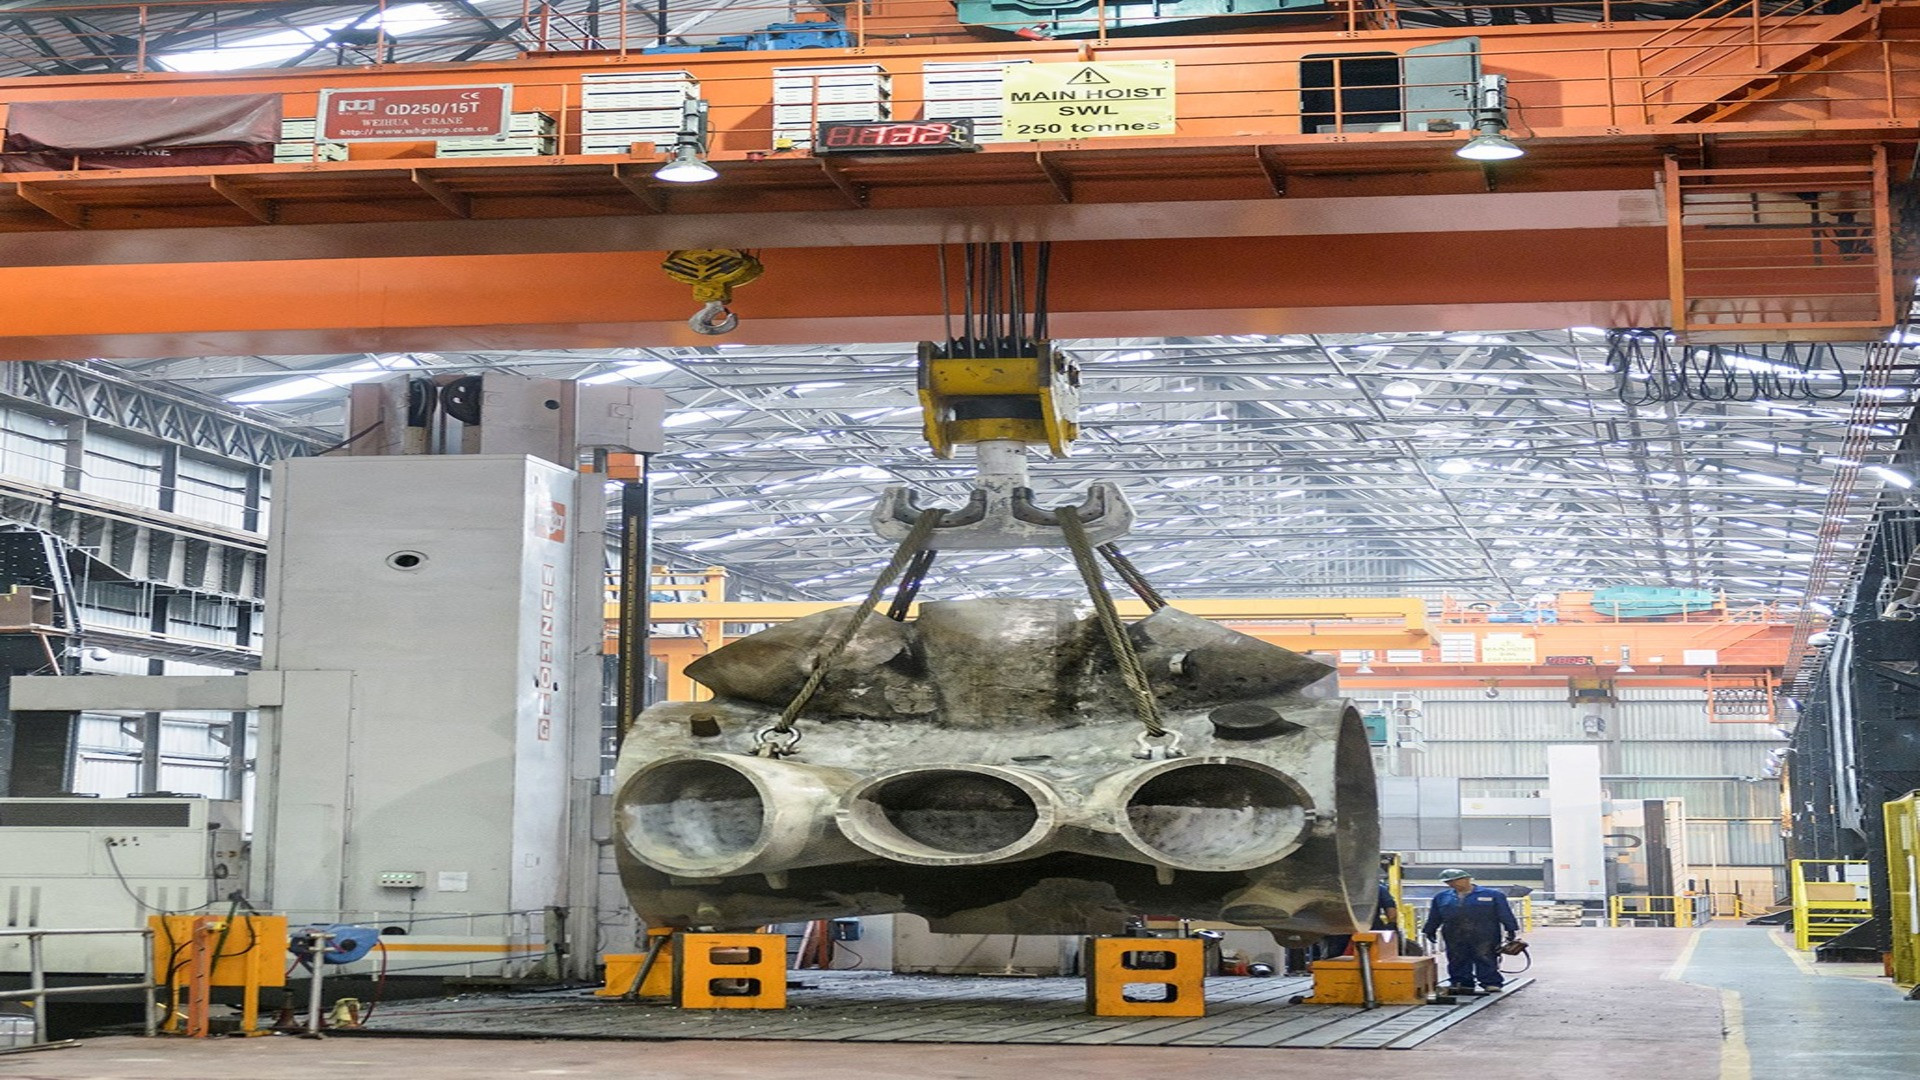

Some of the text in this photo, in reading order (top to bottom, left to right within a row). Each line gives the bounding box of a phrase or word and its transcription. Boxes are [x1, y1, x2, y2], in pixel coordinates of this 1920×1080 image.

[1011, 87, 1167, 101] MAIN HOIST
[385, 102, 480, 115] QD250/15T
[1059, 105, 1119, 116] SWL
[362, 117, 463, 127] WEIHUA CRANE
[1017, 122, 1161, 135] 250 tonnes
